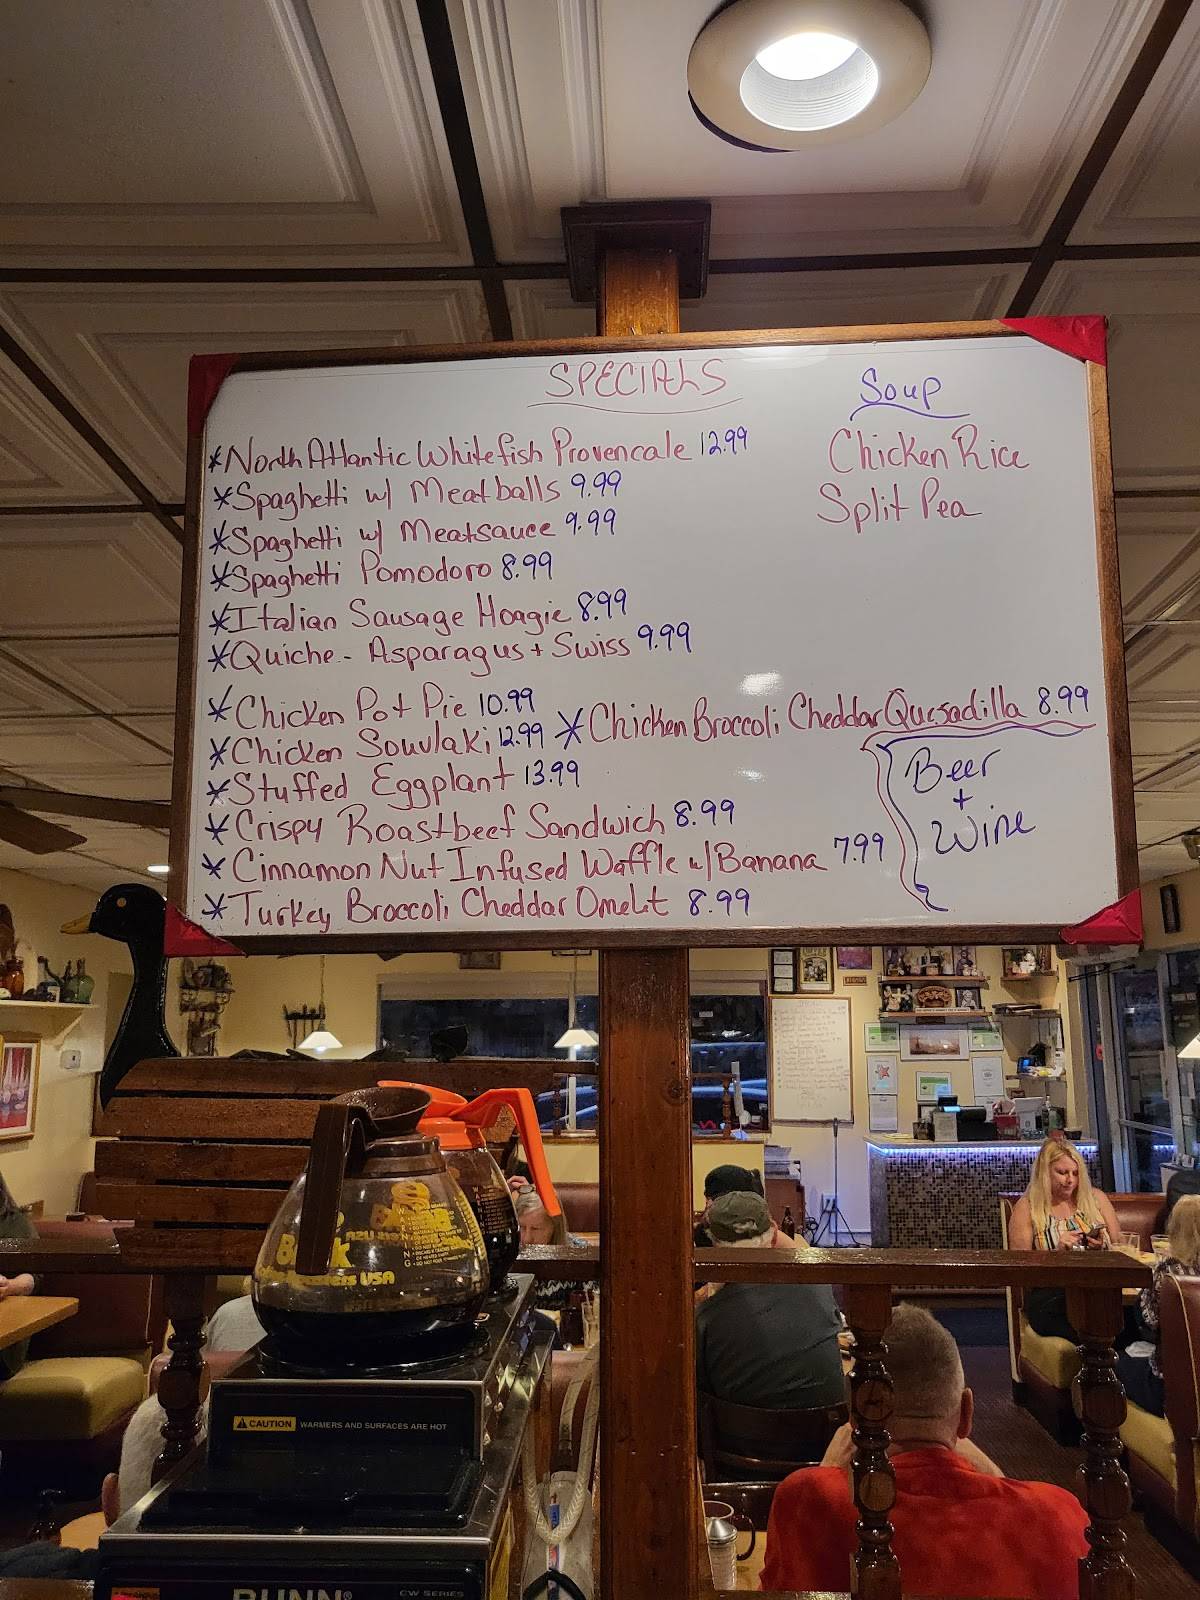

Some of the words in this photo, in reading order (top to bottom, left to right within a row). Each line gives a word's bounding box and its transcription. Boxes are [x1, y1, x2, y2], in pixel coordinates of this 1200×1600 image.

[546, 358, 727, 398] SPECIALS
[861, 367, 942, 410] Soup
[225, 435, 303, 476] North
[307, 436, 412, 469] Atlantic
[418, 433, 543, 468] Whitefish
[551, 426, 693, 467] Provencale
[700, 425, 748, 457] 12.99
[829, 427, 949, 474] Chicken
[951, 423, 1030, 470] Rice
[232, 479, 349, 522] Spaghetti
[366, 477, 392, 510] w/
[570, 469, 622, 499] 9.99
[817, 483, 911, 534] Split
[920, 476, 983, 520] Pea
[227, 525, 343, 562] Spaghetti
[359, 519, 384, 555] w/
[400, 517, 557, 544] Meatsauce
[565, 508, 617, 536] 9.99
[231, 561, 342, 598] Spaghetti
[360, 549, 492, 585] Pomodoro
[501, 550, 554, 581] 8.99
[228, 602, 338, 634] Italian
[350, 598, 466, 637] Sausage
[476, 592, 573, 636] Hoagie
[577, 587, 628, 623] 8.99
[368, 635, 525, 678] Asparagus
[551, 631, 631, 659] Swiss
[637, 621, 693, 654] 9.99
[236, 694, 345, 730] Chicken
[356, 685, 412, 722] Pot
[422, 681, 467, 719] Pie
[479, 687, 536, 717] 10.99
[589, 701, 688, 743] Chicken
[693, 696, 780, 743] Broccoli
[787, 691, 881, 731] Cheddar
[1037, 685, 1090, 717] 8.99
[231, 736, 343, 766] Chicken
[356, 719, 492, 758] Souvlaki
[499, 721, 545, 749] 12.99
[228, 771, 348, 806] Stuffed
[371, 755, 516, 811] Eggplant
[525, 759, 580, 788] 13.99
[904, 746, 1002, 794] Beer
[235, 808, 324, 845] Crispy
[337, 802, 517, 846] Roastbeef
[525, 801, 666, 840] Sandwich
[674, 798, 736, 828] 8.99
[930, 803, 1037, 855] Wine
[232, 846, 372, 883] Cinnamon
[380, 849, 446, 880] Nut
[446, 845, 568, 884] Infused
[581, 839, 680, 879] Waffle
[834, 832, 885, 864] 7.99
[227, 890, 332, 934] Turkey
[346, 886, 449, 923] Broccoli
[461, 885, 568, 919] Cheddar
[688, 887, 751, 918] 8.99
[360, 1270, 396, 1287] USA
[249, 1420, 292, 1429] CAUTION
[300, 1420, 344, 1430] WARMERS
[344, 1421, 364, 1430] AND
[364, 1421, 409, 1431] SURFACES
[410, 1422, 428, 1431] ARE
[429, 1422, 448, 1431] HOT
[399, 1589, 420, 1598] CW
[423, 1590, 465, 1598] SERIES
